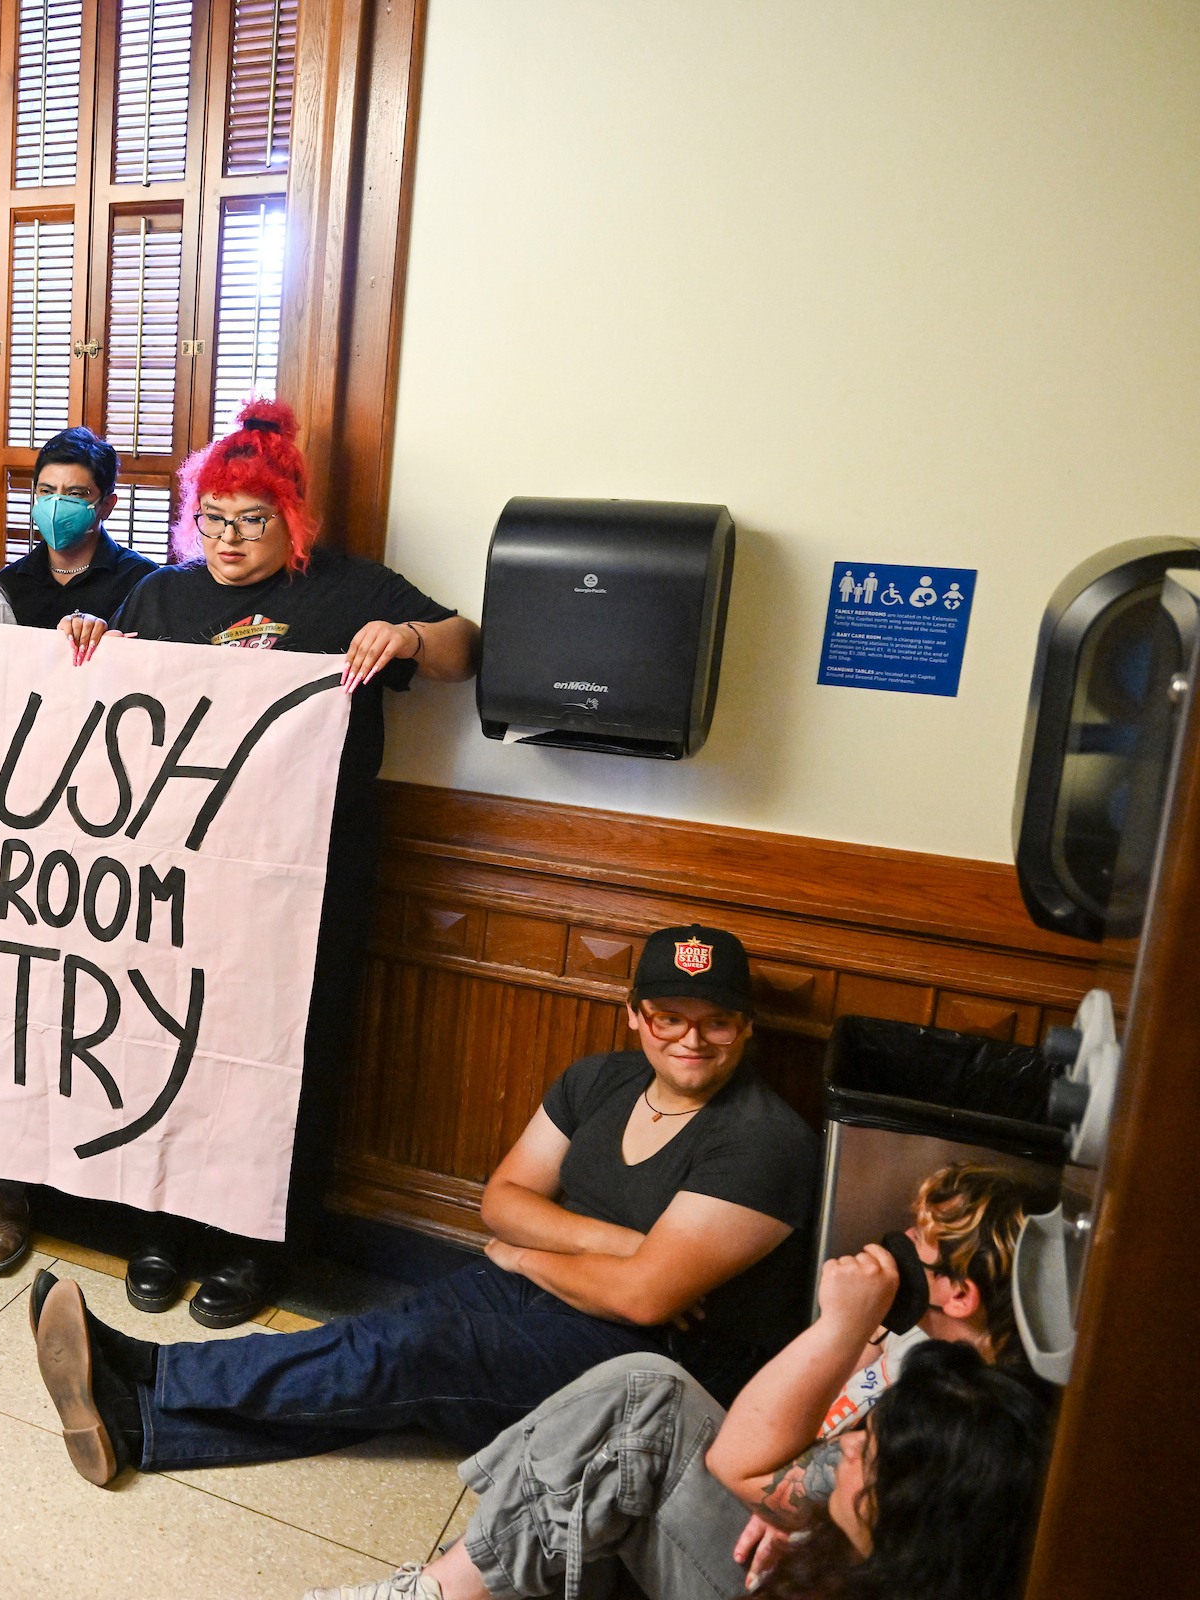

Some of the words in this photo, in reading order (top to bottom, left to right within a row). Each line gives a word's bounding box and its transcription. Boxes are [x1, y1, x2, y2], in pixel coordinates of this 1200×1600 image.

[234, 626, 264, 637] ABORTION
[553, 681, 608, 692] enMotion
[679, 954, 708, 964] STAR
